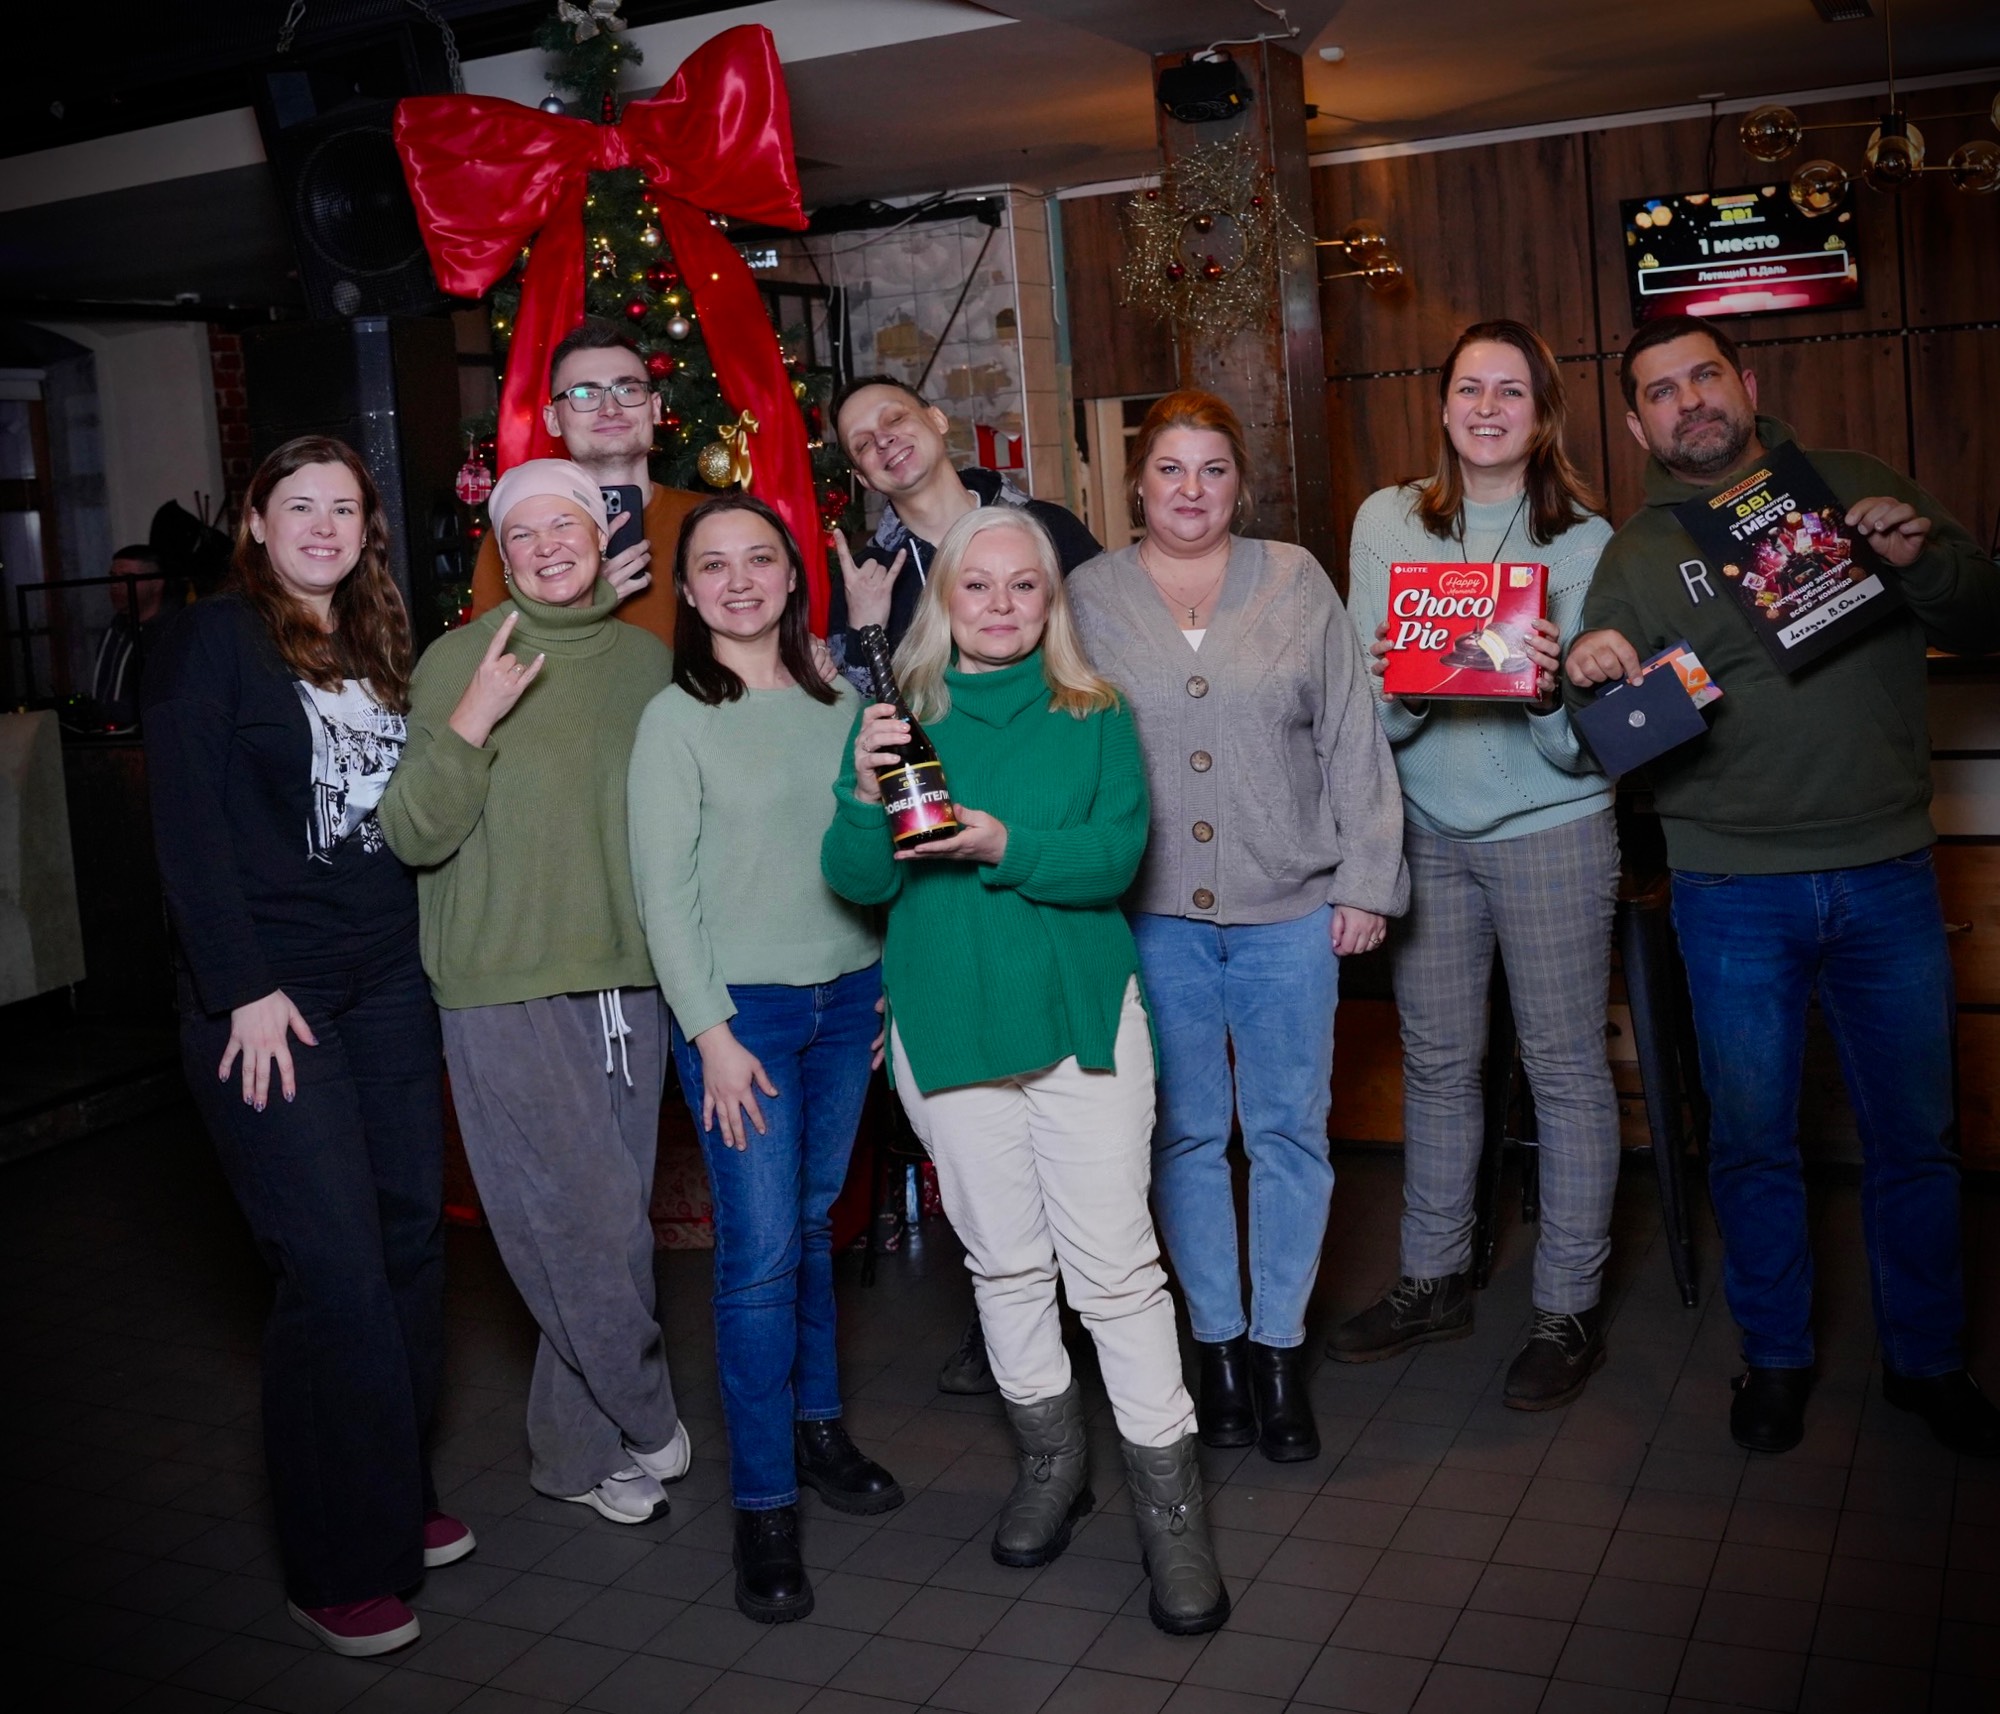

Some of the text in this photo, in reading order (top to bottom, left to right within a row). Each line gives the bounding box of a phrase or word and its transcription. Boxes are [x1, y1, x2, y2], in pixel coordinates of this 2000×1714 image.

[1698, 238, 1709, 256] 1
[1710, 470, 1770, 507] КВИЗМАШИНА
[1731, 498, 1797, 541] 1 МЕСТО
[1446, 576, 1481, 588] Happy
[1679, 559, 1715, 604] R
[1769, 558, 1852, 610] Настоящие эксперты
[1802, 578, 1836, 601] области
[1393, 588, 1494, 618] Choco
[1789, 601, 1813, 618] всего
[1817, 577, 1853, 601] команда
[1393, 621, 1449, 650] Pie
[1514, 680, 1526, 690] 12
[884, 790, 950, 814] ОБЕДИТЕЛИ
